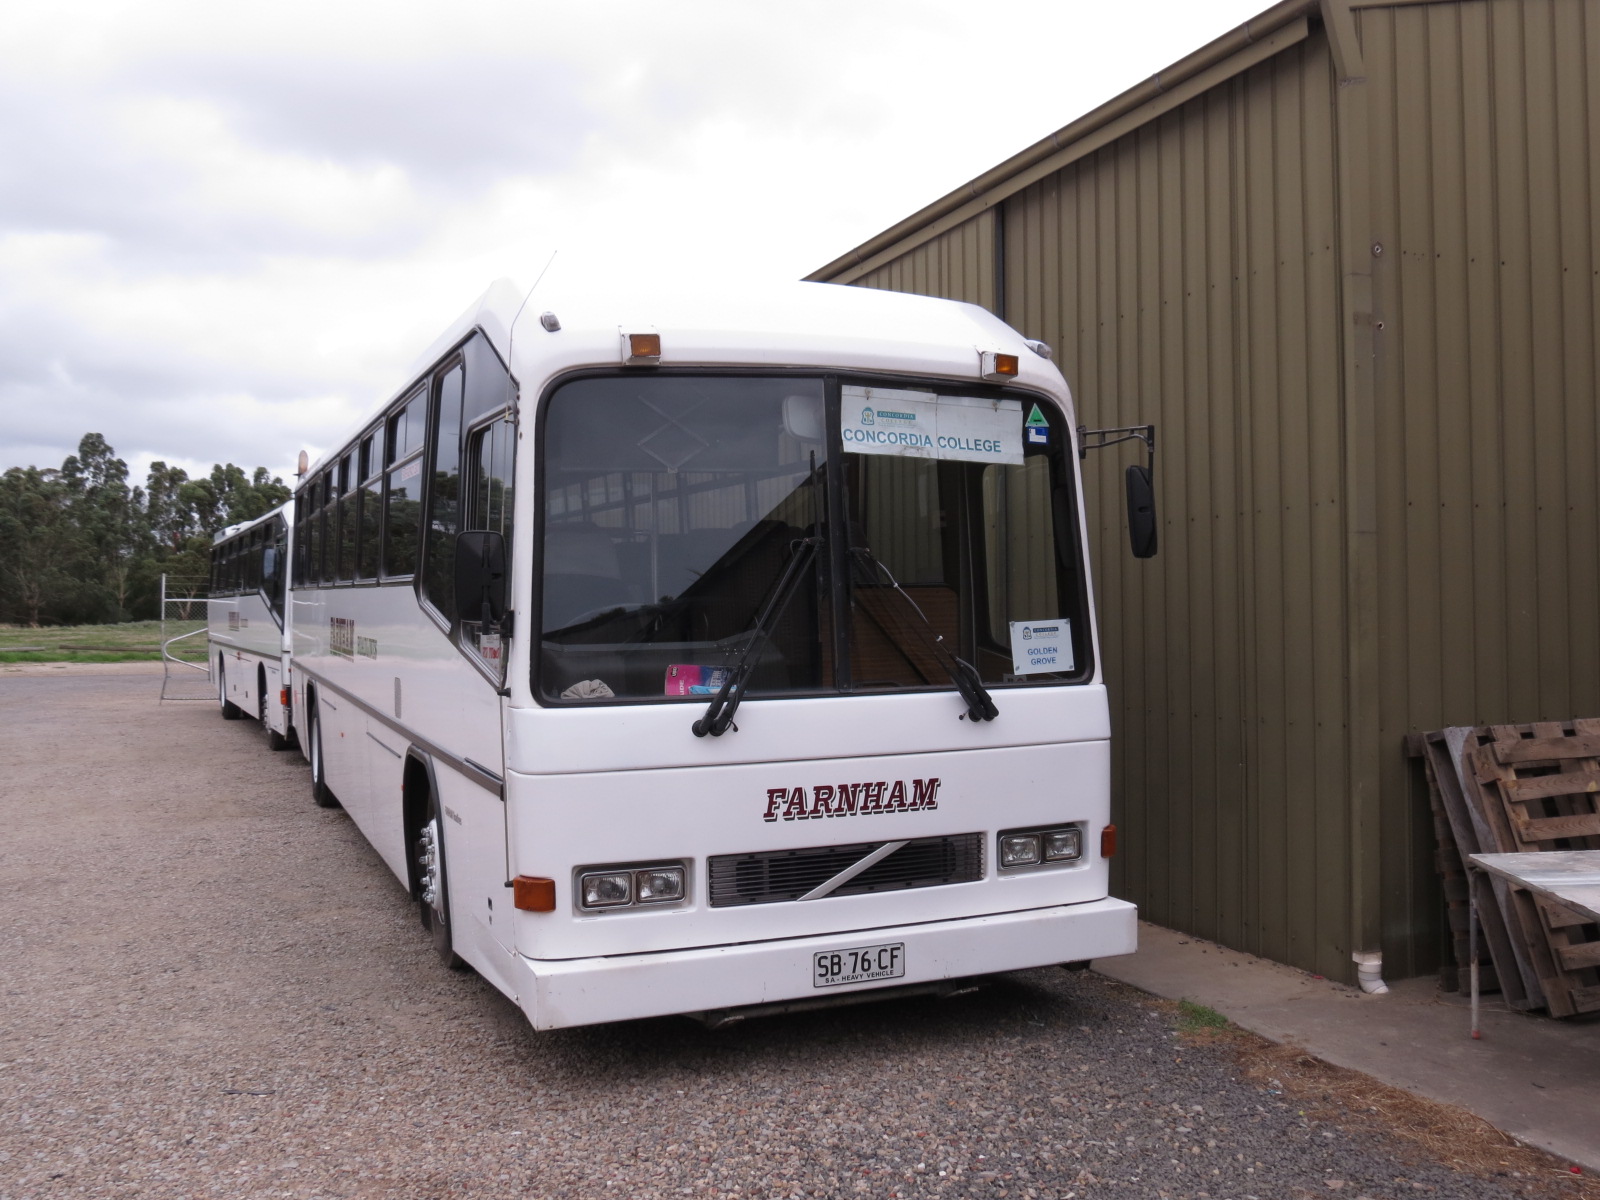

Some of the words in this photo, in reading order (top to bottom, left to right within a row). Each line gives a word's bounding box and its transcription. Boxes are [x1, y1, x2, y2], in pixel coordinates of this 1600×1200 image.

[879, 411, 914, 419] CONCORDIA
[843, 428, 933, 447] CONCORDIA
[937, 436, 1001, 453] COLLEGE
[1027, 647, 1058, 656] GOLDEN
[1030, 657, 1057, 665] GROVE
[763, 777, 942, 822] FARNHAM
[841, 974, 863, 982] HEAVY
[866, 969, 894, 978] VEHICLE
